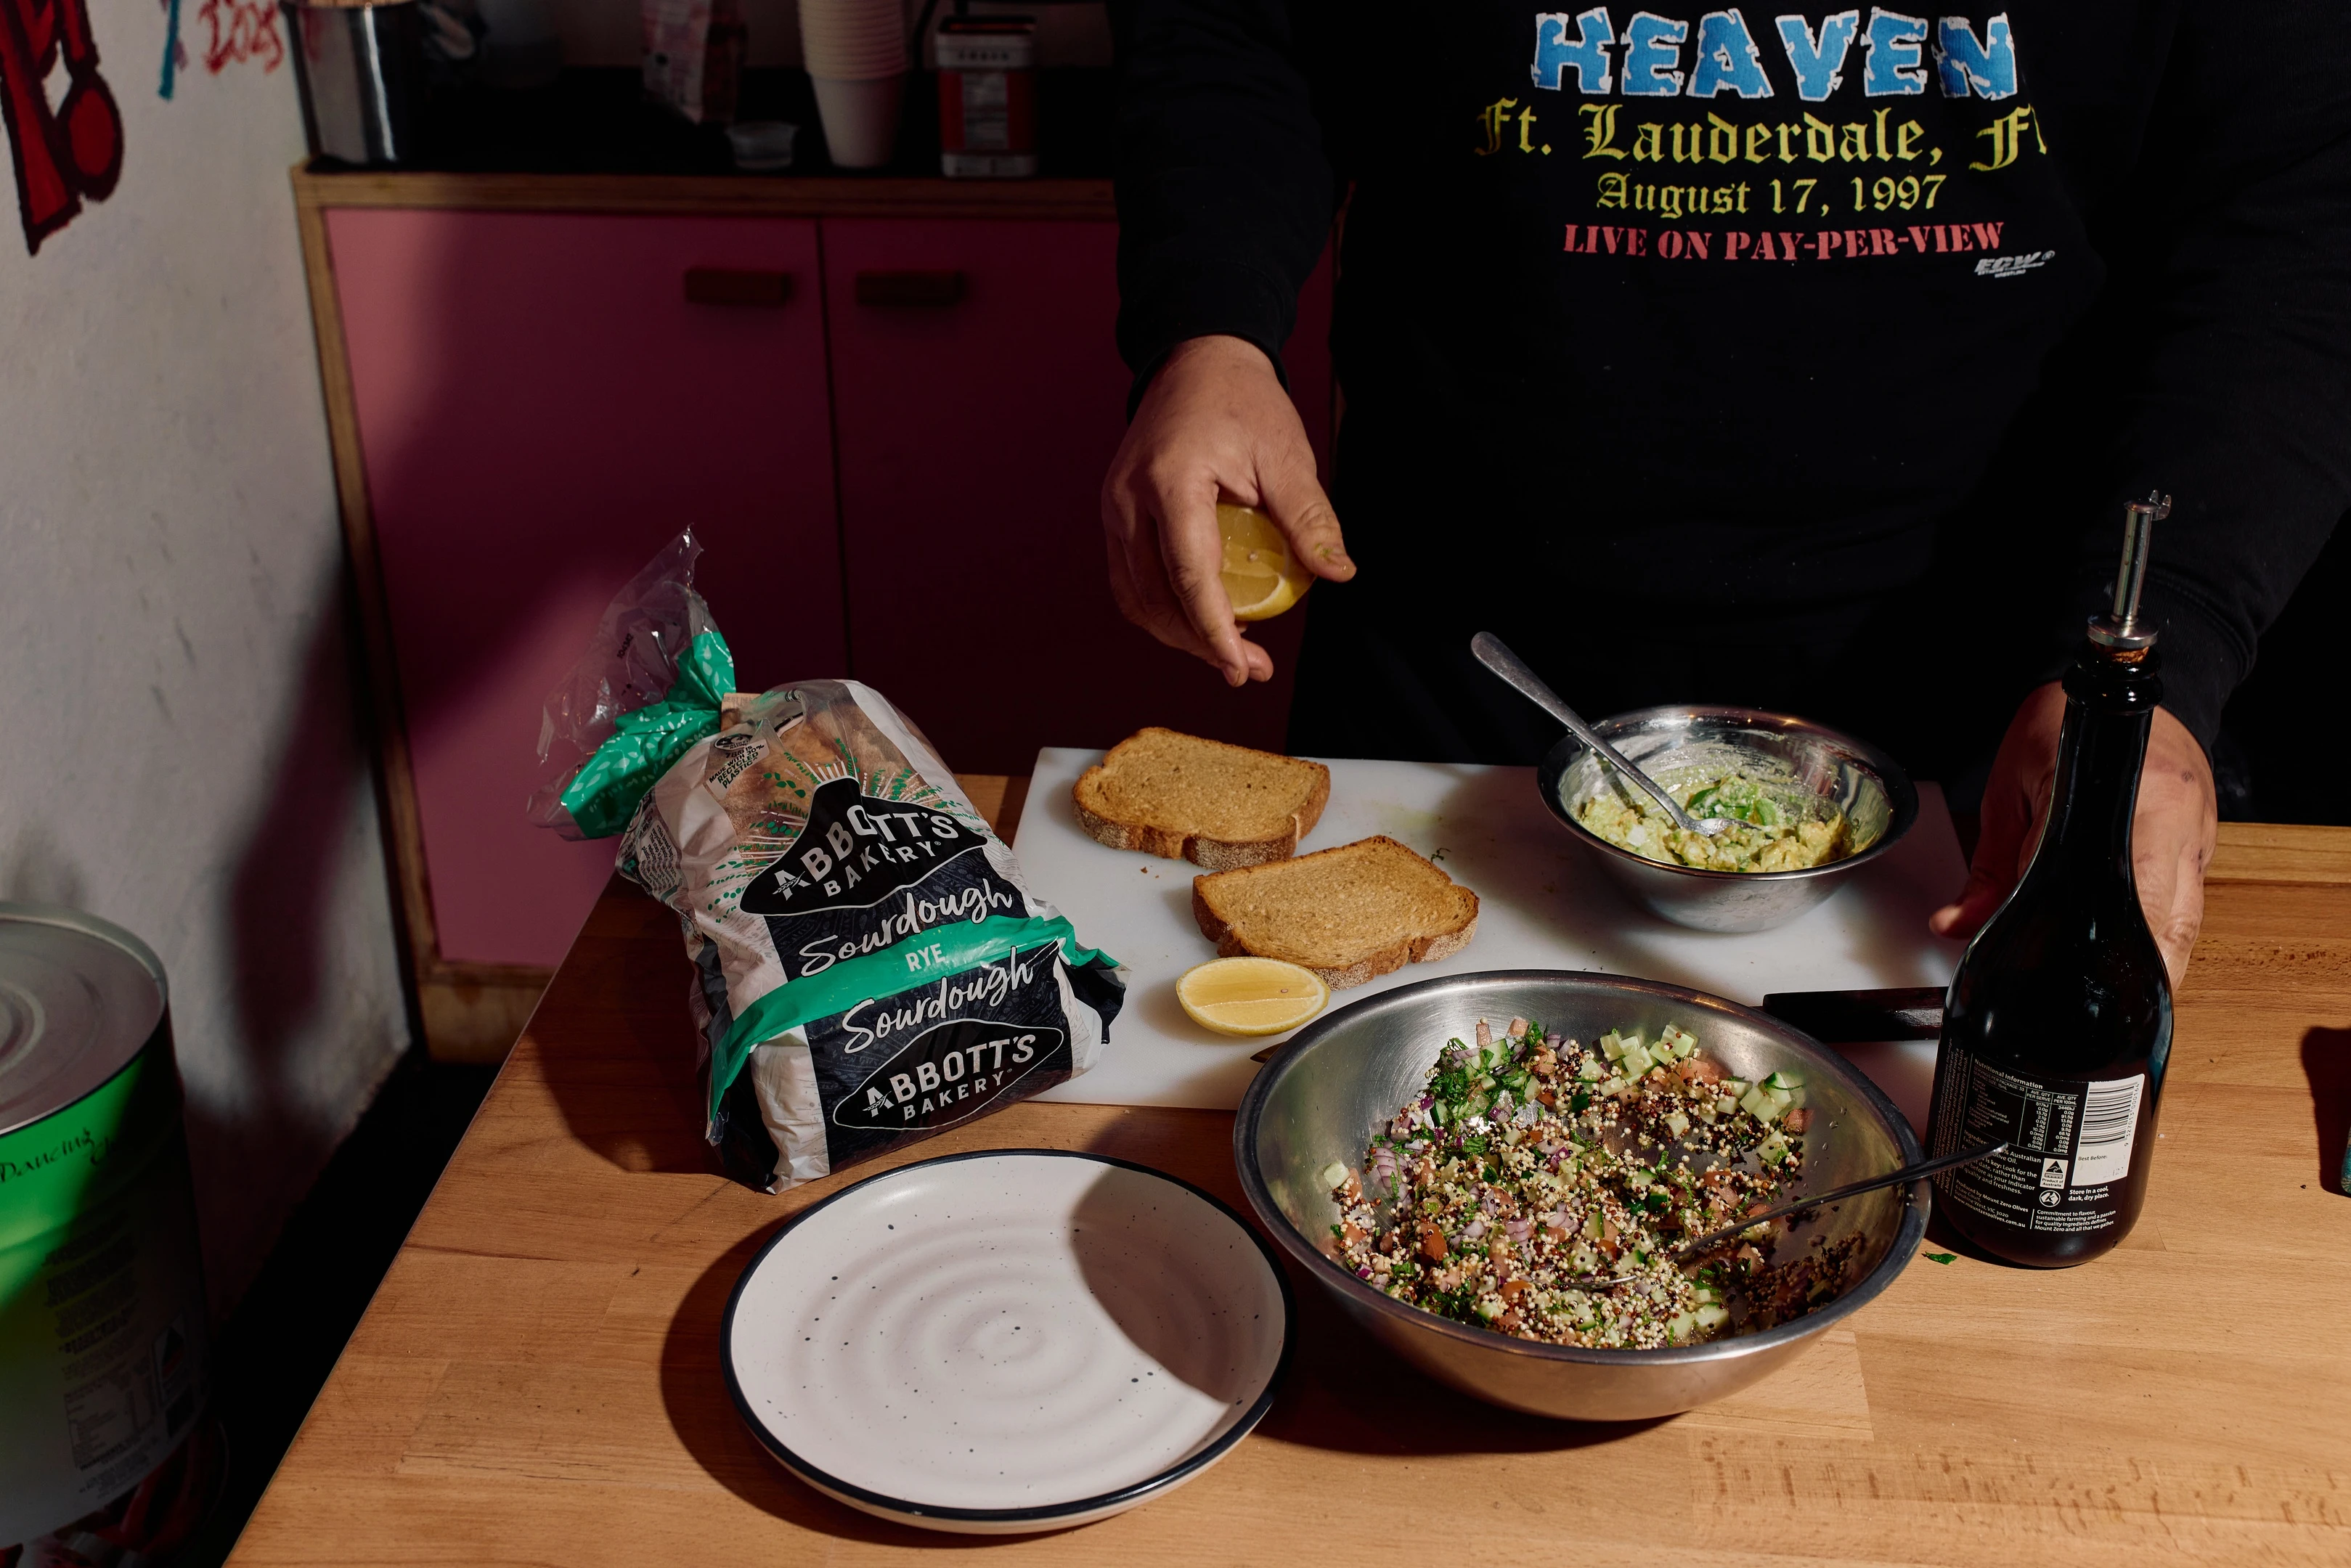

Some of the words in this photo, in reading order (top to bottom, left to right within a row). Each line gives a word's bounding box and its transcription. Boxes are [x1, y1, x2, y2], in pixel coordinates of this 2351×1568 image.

[1530, 6, 2018, 102] HEAVEN
[1473, 97, 1552, 158] Ft.
[1578, 103, 1944, 167] Lauderdale,
[1597, 172, 1750, 219] August
[1769, 179, 1830, 217] 17,
[1850, 174, 1947, 212] 1997
[1563, 224, 1647, 257] LIVE
[1658, 230, 1712, 261] ON
[1725, 221, 2005, 261] PAY-PER-VIEW
[709, 767, 726, 783] MADE
[728, 754, 745, 767] WITH
[746, 745, 765, 755] 30%
[717, 752, 759, 783] RECYCLED
[772, 802, 960, 901] ABBOTT'S
[800, 878, 1013, 977] Sourdough
[905, 943, 947, 973] RYE
[842, 946, 1034, 1055] Sourdough
[863, 1033, 1037, 1118] ABBOTT'S
[1975, 1058, 2004, 1077] Nutritional
[2005, 1074, 2043, 1089] Information
[903, 1074, 1003, 1122] BAKERY
[1979, 1161, 1992, 1172] date,
[1992, 1168, 2010, 1178] rather
[2002, 1164, 2016, 1173] Look
[2010, 1151, 2041, 1164] Australian
[1956, 1179, 1976, 1194] Produced
[1982, 1194, 1999, 1204] Mount
[1964, 1167, 1981, 1180] quality
[1981, 1176, 1992, 1185] and
[1993, 1180, 2021, 1195] freshness.
[1970, 1164, 1986, 1175] before
[1994, 1175, 2007, 1184] your
[2008, 1179, 2035, 1191] indicator
[1954, 1195, 2026, 1228] www.mountzeroolives.com.au
